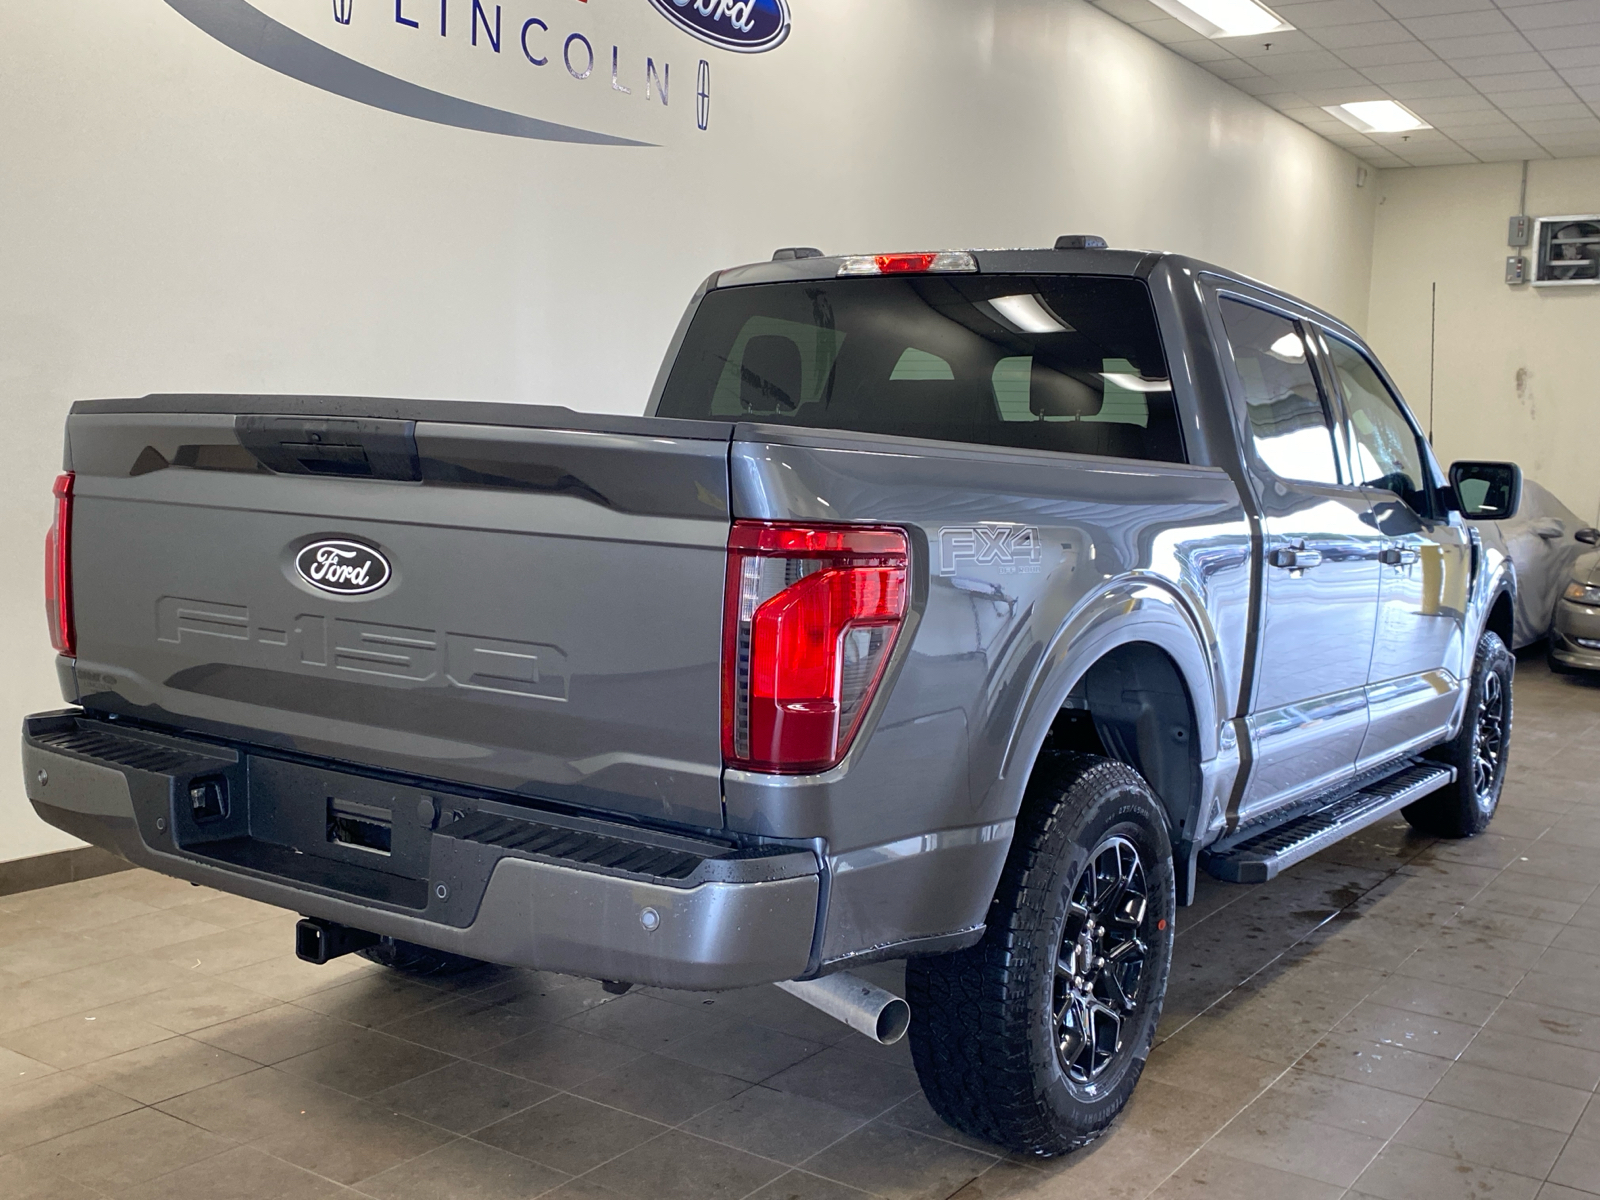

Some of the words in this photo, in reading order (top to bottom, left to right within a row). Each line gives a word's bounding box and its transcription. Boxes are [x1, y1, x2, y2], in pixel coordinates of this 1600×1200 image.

[672, 0, 755, 33] ord
[395, 0, 669, 106] LINCOLN
[310, 547, 371, 586] Ford
[938, 525, 1042, 577] FX4
[155, 595, 569, 703] F-150
